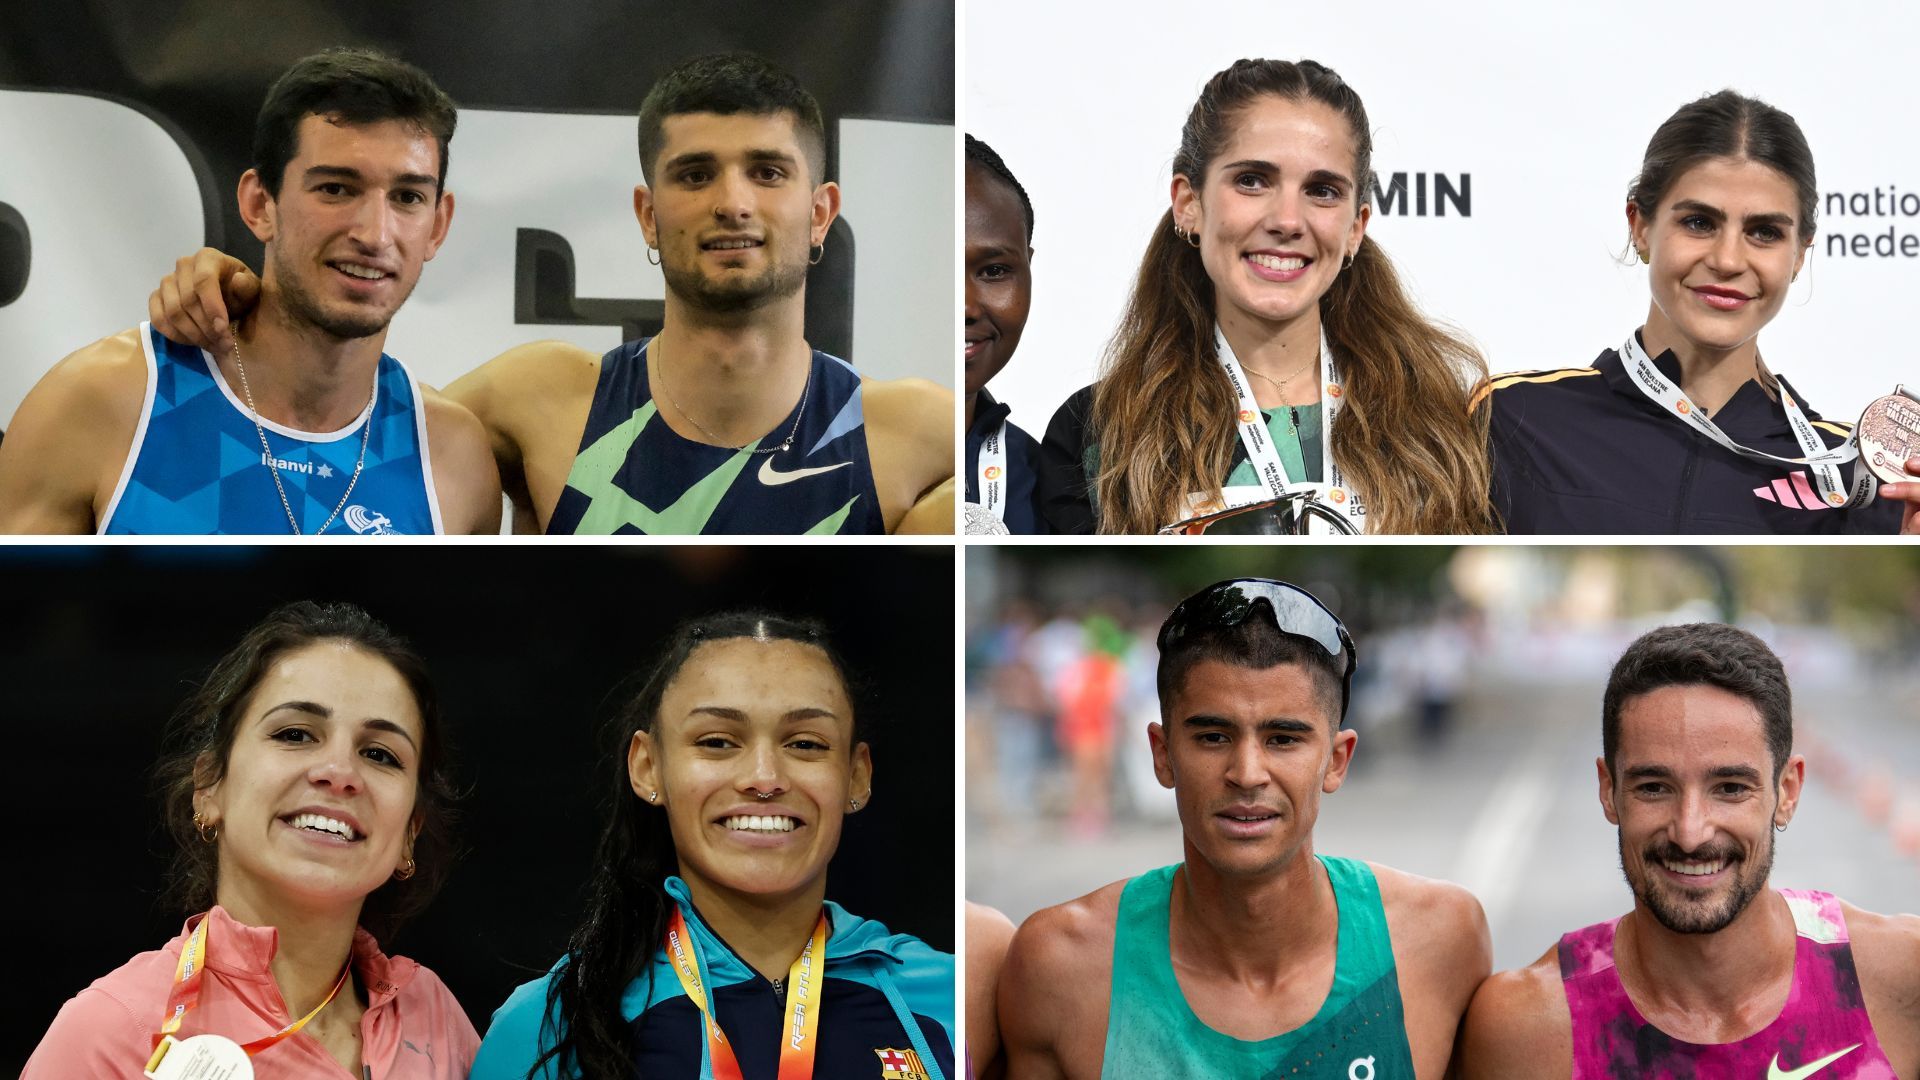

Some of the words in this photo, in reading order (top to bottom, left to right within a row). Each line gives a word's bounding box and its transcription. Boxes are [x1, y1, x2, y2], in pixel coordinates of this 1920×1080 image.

[1370, 171, 1471, 217] MIN
[1826, 185, 1920, 216] natio
[1826, 225, 1920, 257] nede
[1637, 368, 1661, 395] VALLECANA
[790, 1003, 806, 1051] RFEA
